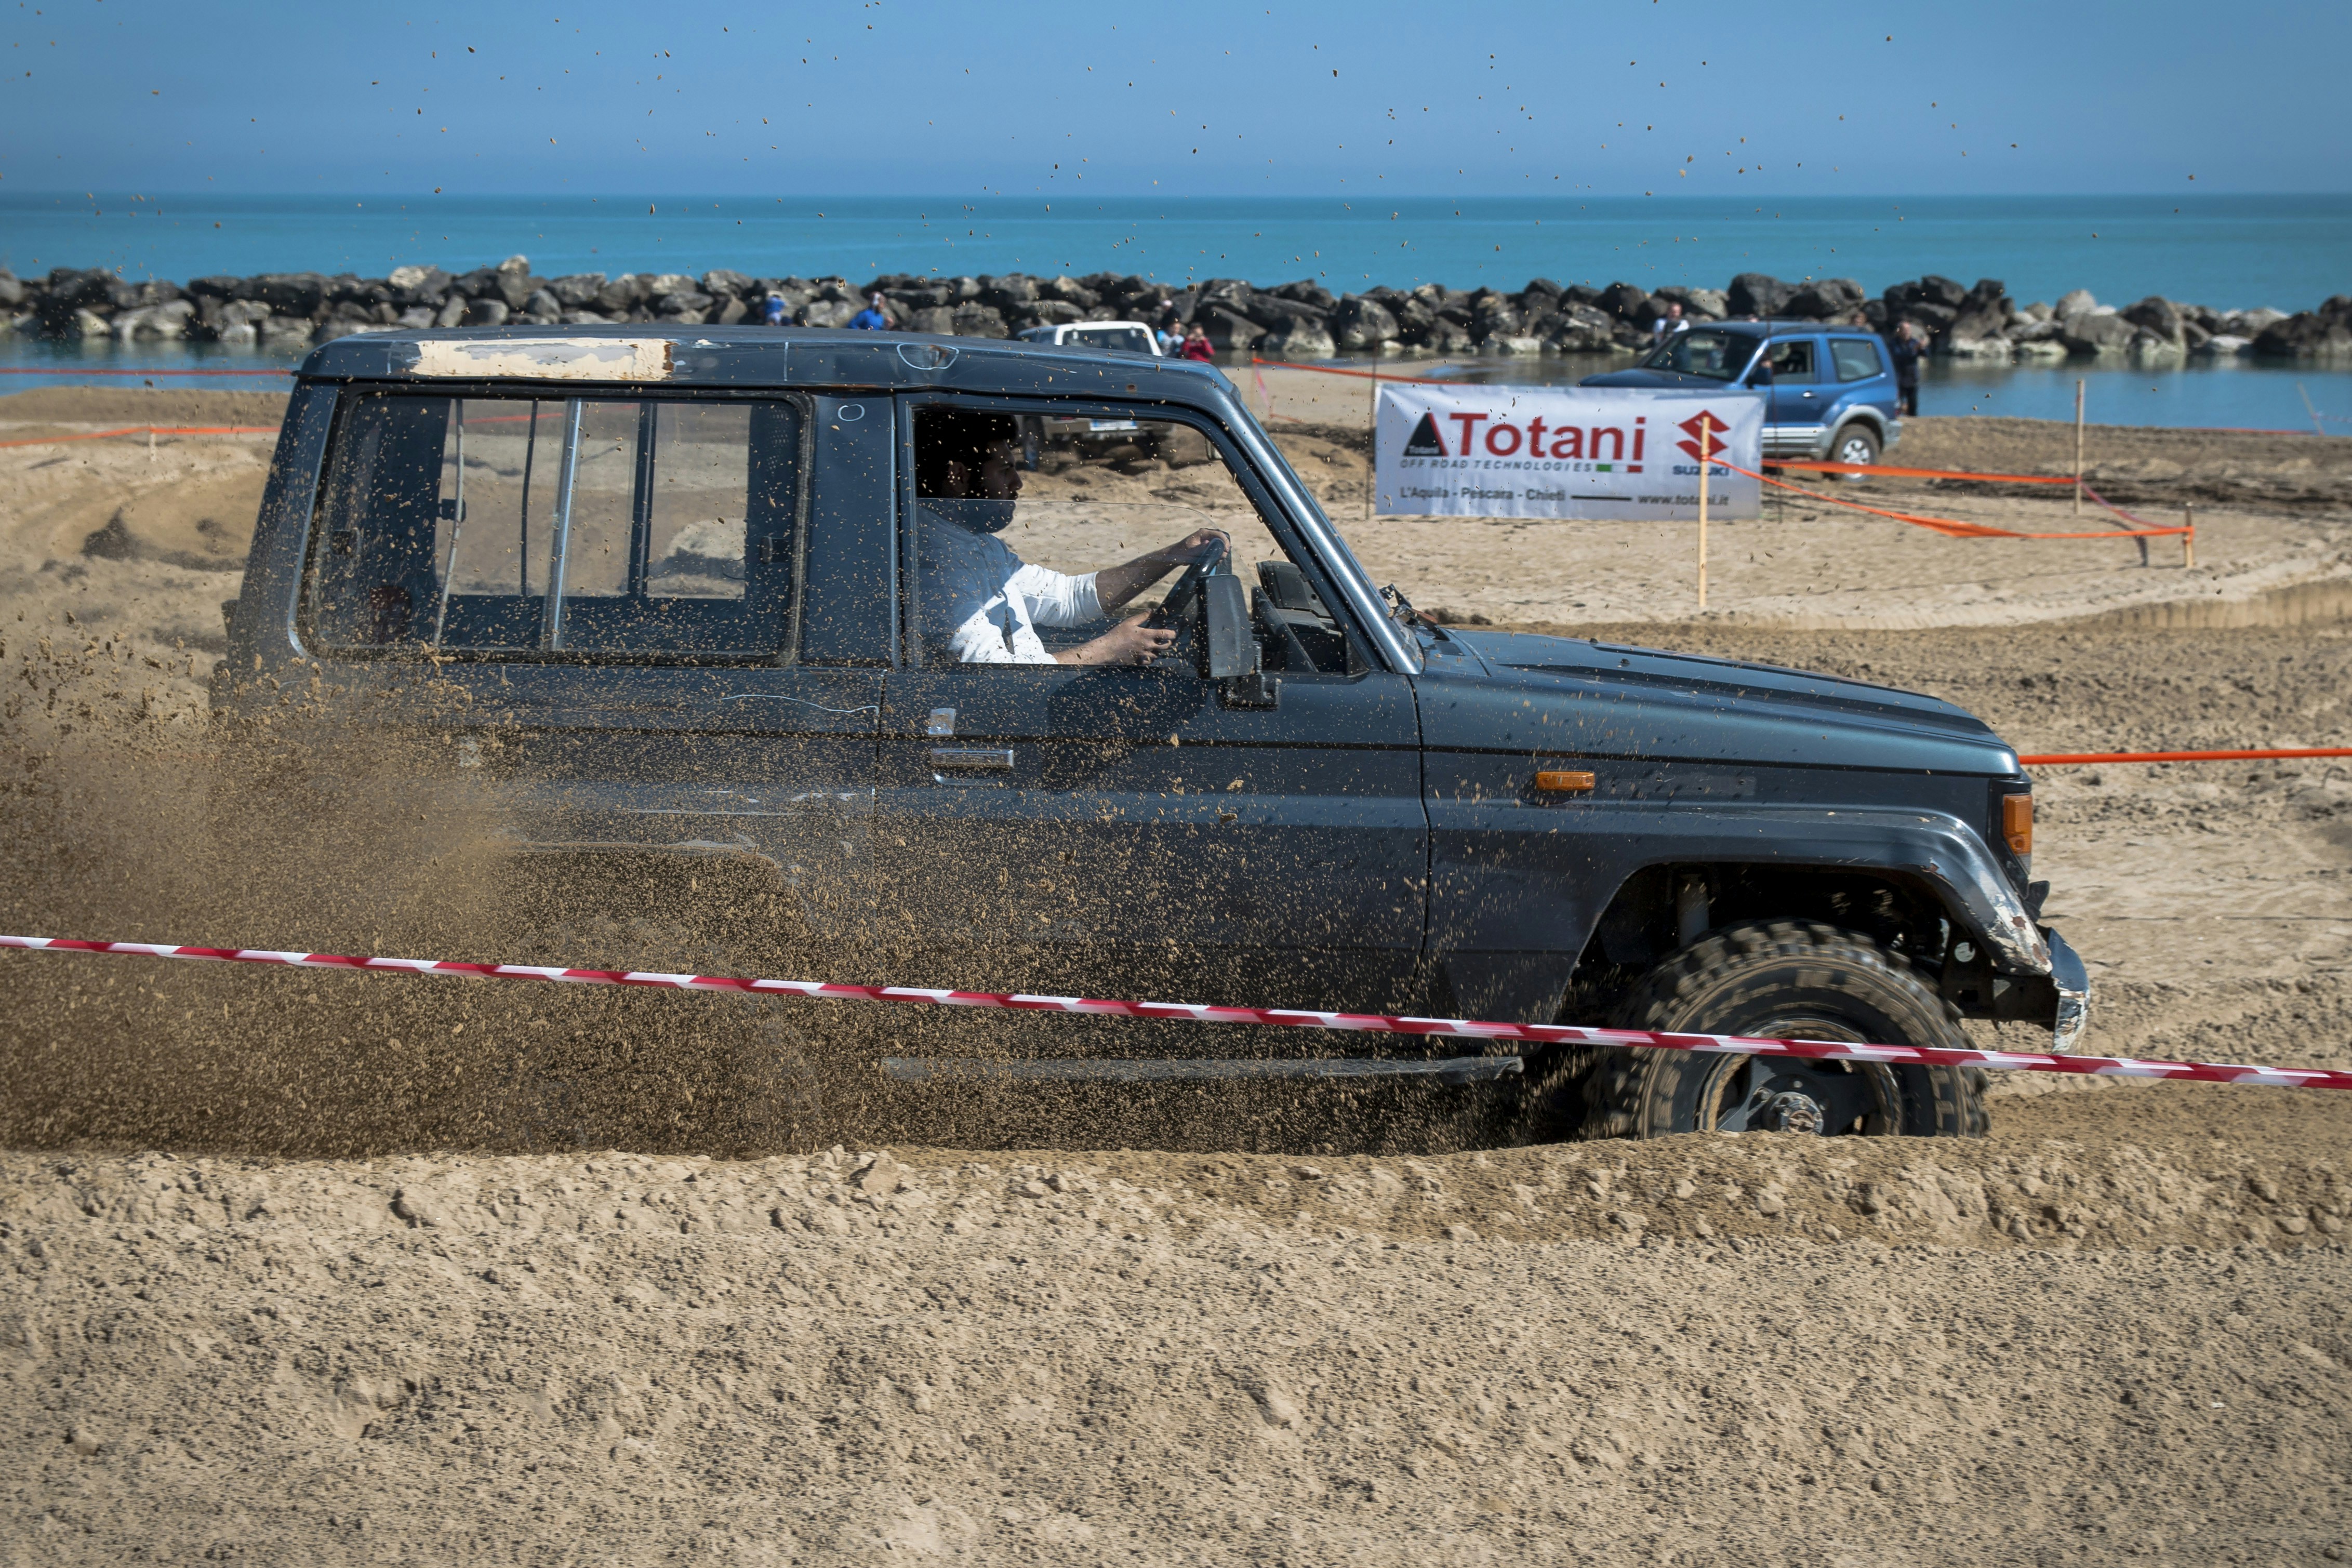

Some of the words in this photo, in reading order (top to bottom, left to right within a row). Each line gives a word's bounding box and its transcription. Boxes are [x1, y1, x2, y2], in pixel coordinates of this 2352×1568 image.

[1449, 412, 1646, 461] Totani
[1400, 459, 1425, 469] OFF
[1431, 459, 1468, 469] ROAD
[1474, 460, 1592, 472] TECHNOLOGIES
[1400, 486, 1449, 500] L'Aquila
[1460, 487, 1514, 500] Pescara
